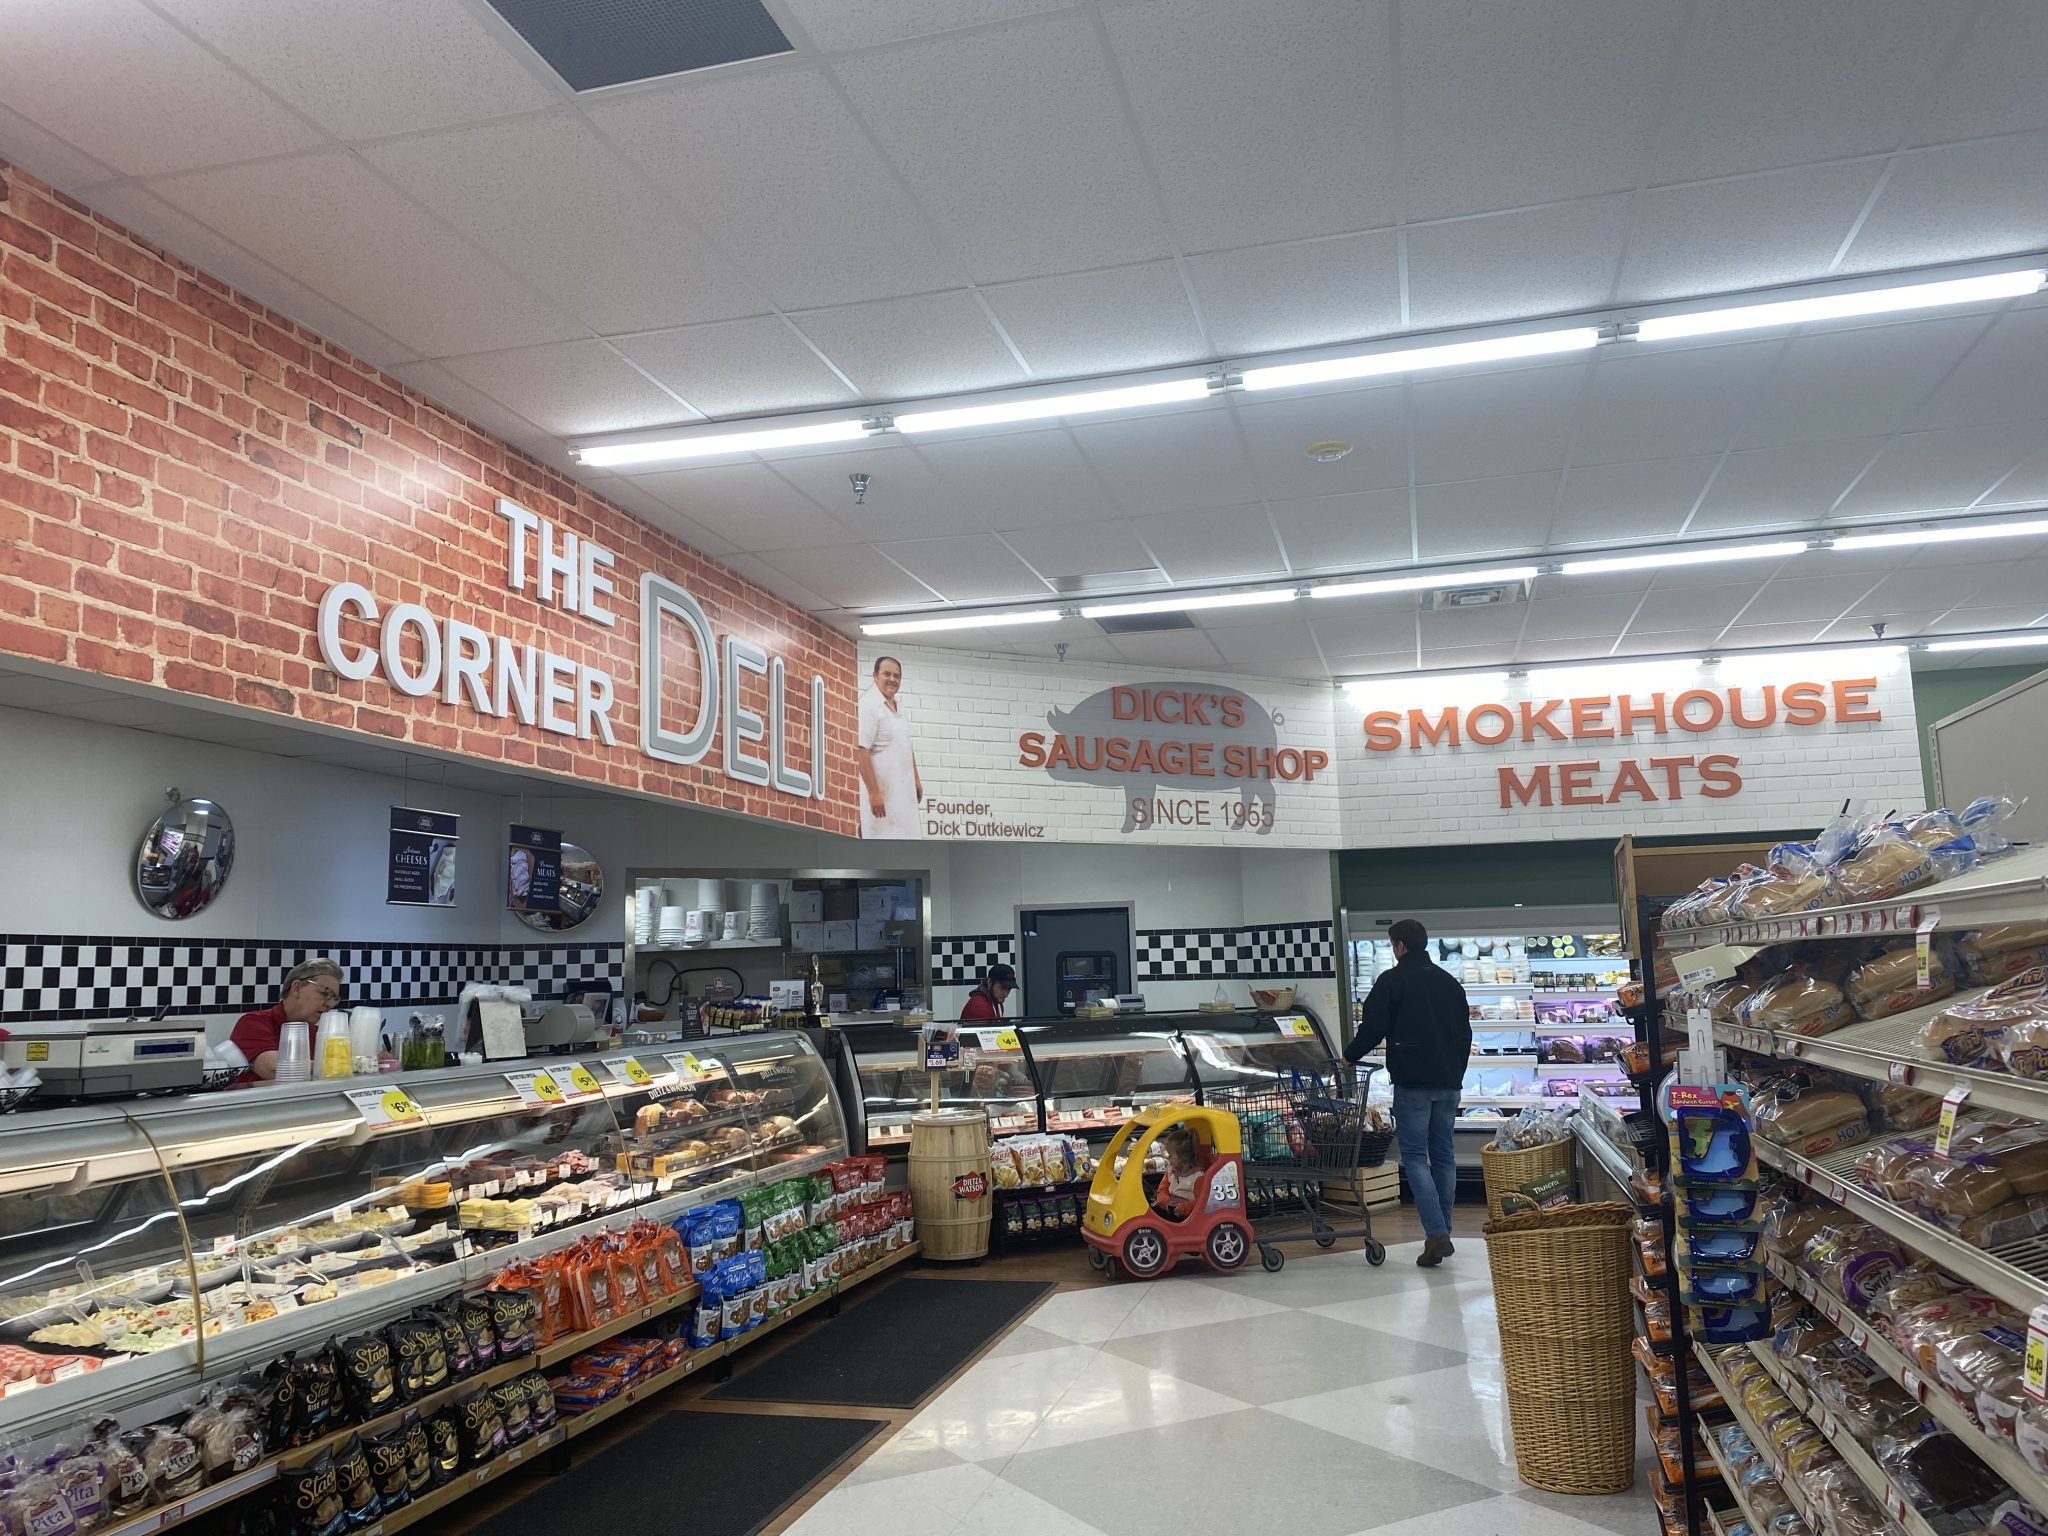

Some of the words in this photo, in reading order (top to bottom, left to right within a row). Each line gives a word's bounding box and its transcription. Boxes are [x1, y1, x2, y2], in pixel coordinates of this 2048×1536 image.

[495, 499, 615, 627] THE
[317, 582, 617, 747] CORNER
[640, 571, 825, 801] DELI
[1363, 676, 1882, 752] SMOKEHOUSE
[1019, 732, 1216, 777] SAUSAGE
[1223, 744, 1329, 781] SHOP
[1498, 754, 1743, 810] MEATS
[926, 798, 994, 818] Founder,
[1131, 797, 1212, 827] SINCE
[1220, 800, 1275, 829] 1955
[926, 820, 961, 837] Dick
[965, 820, 1045, 839] Dutkiewicz
[395, 853, 428, 866] CHEESES
[537, 867, 556, 877] MEATS
[1899, 866, 1923, 887] HOT
[1803, 895, 1825, 911] HOT
[647, 1085, 667, 1100] DIETZ
[670, 1083, 697, 1093] WATSON
[1671, 1091, 1697, 1099] T-Rex
[1835, 1123, 1862, 1143] HOT
[959, 1184, 984, 1194] WATSON
[962, 1178, 979, 1187] DIETZ
[1213, 1182, 1239, 1201] 35
[1863, 1269, 1893, 1299] Swirl
[307, 1402, 320, 1413] RISE
[165, 1451, 194, 1475] Pita
[30, 1507, 67, 1533] Pita
